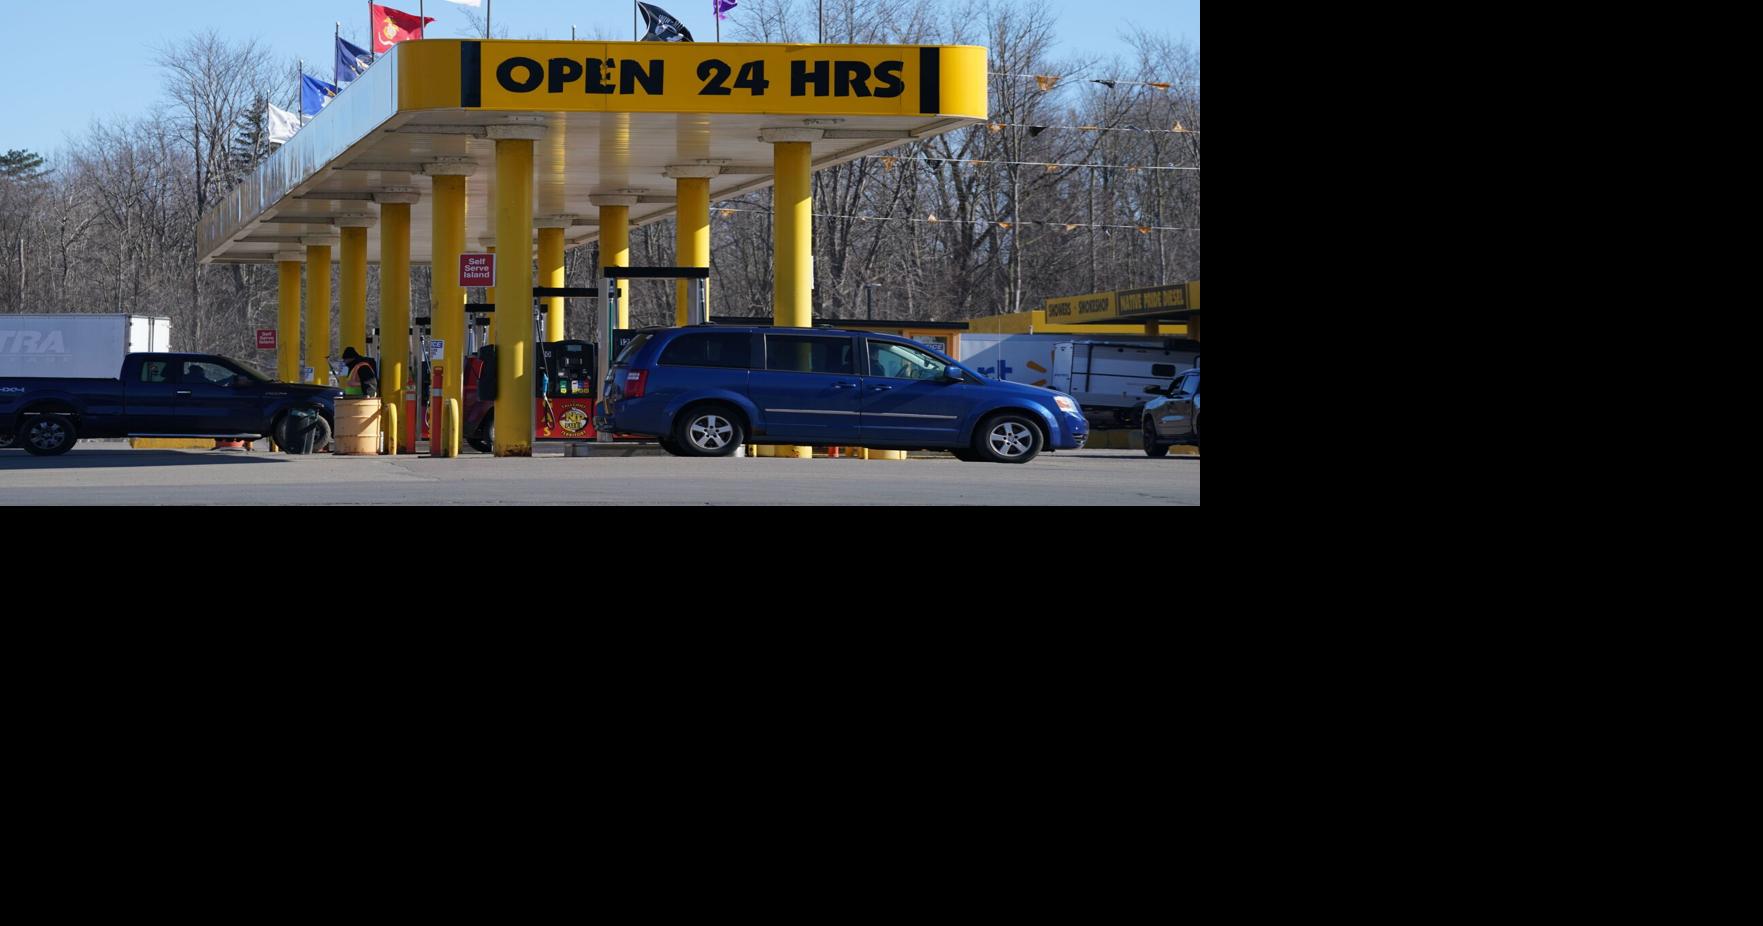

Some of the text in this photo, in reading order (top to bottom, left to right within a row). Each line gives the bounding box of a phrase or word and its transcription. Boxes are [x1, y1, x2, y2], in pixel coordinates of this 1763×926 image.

[496, 57, 905, 98] OPEN 24 HRS
